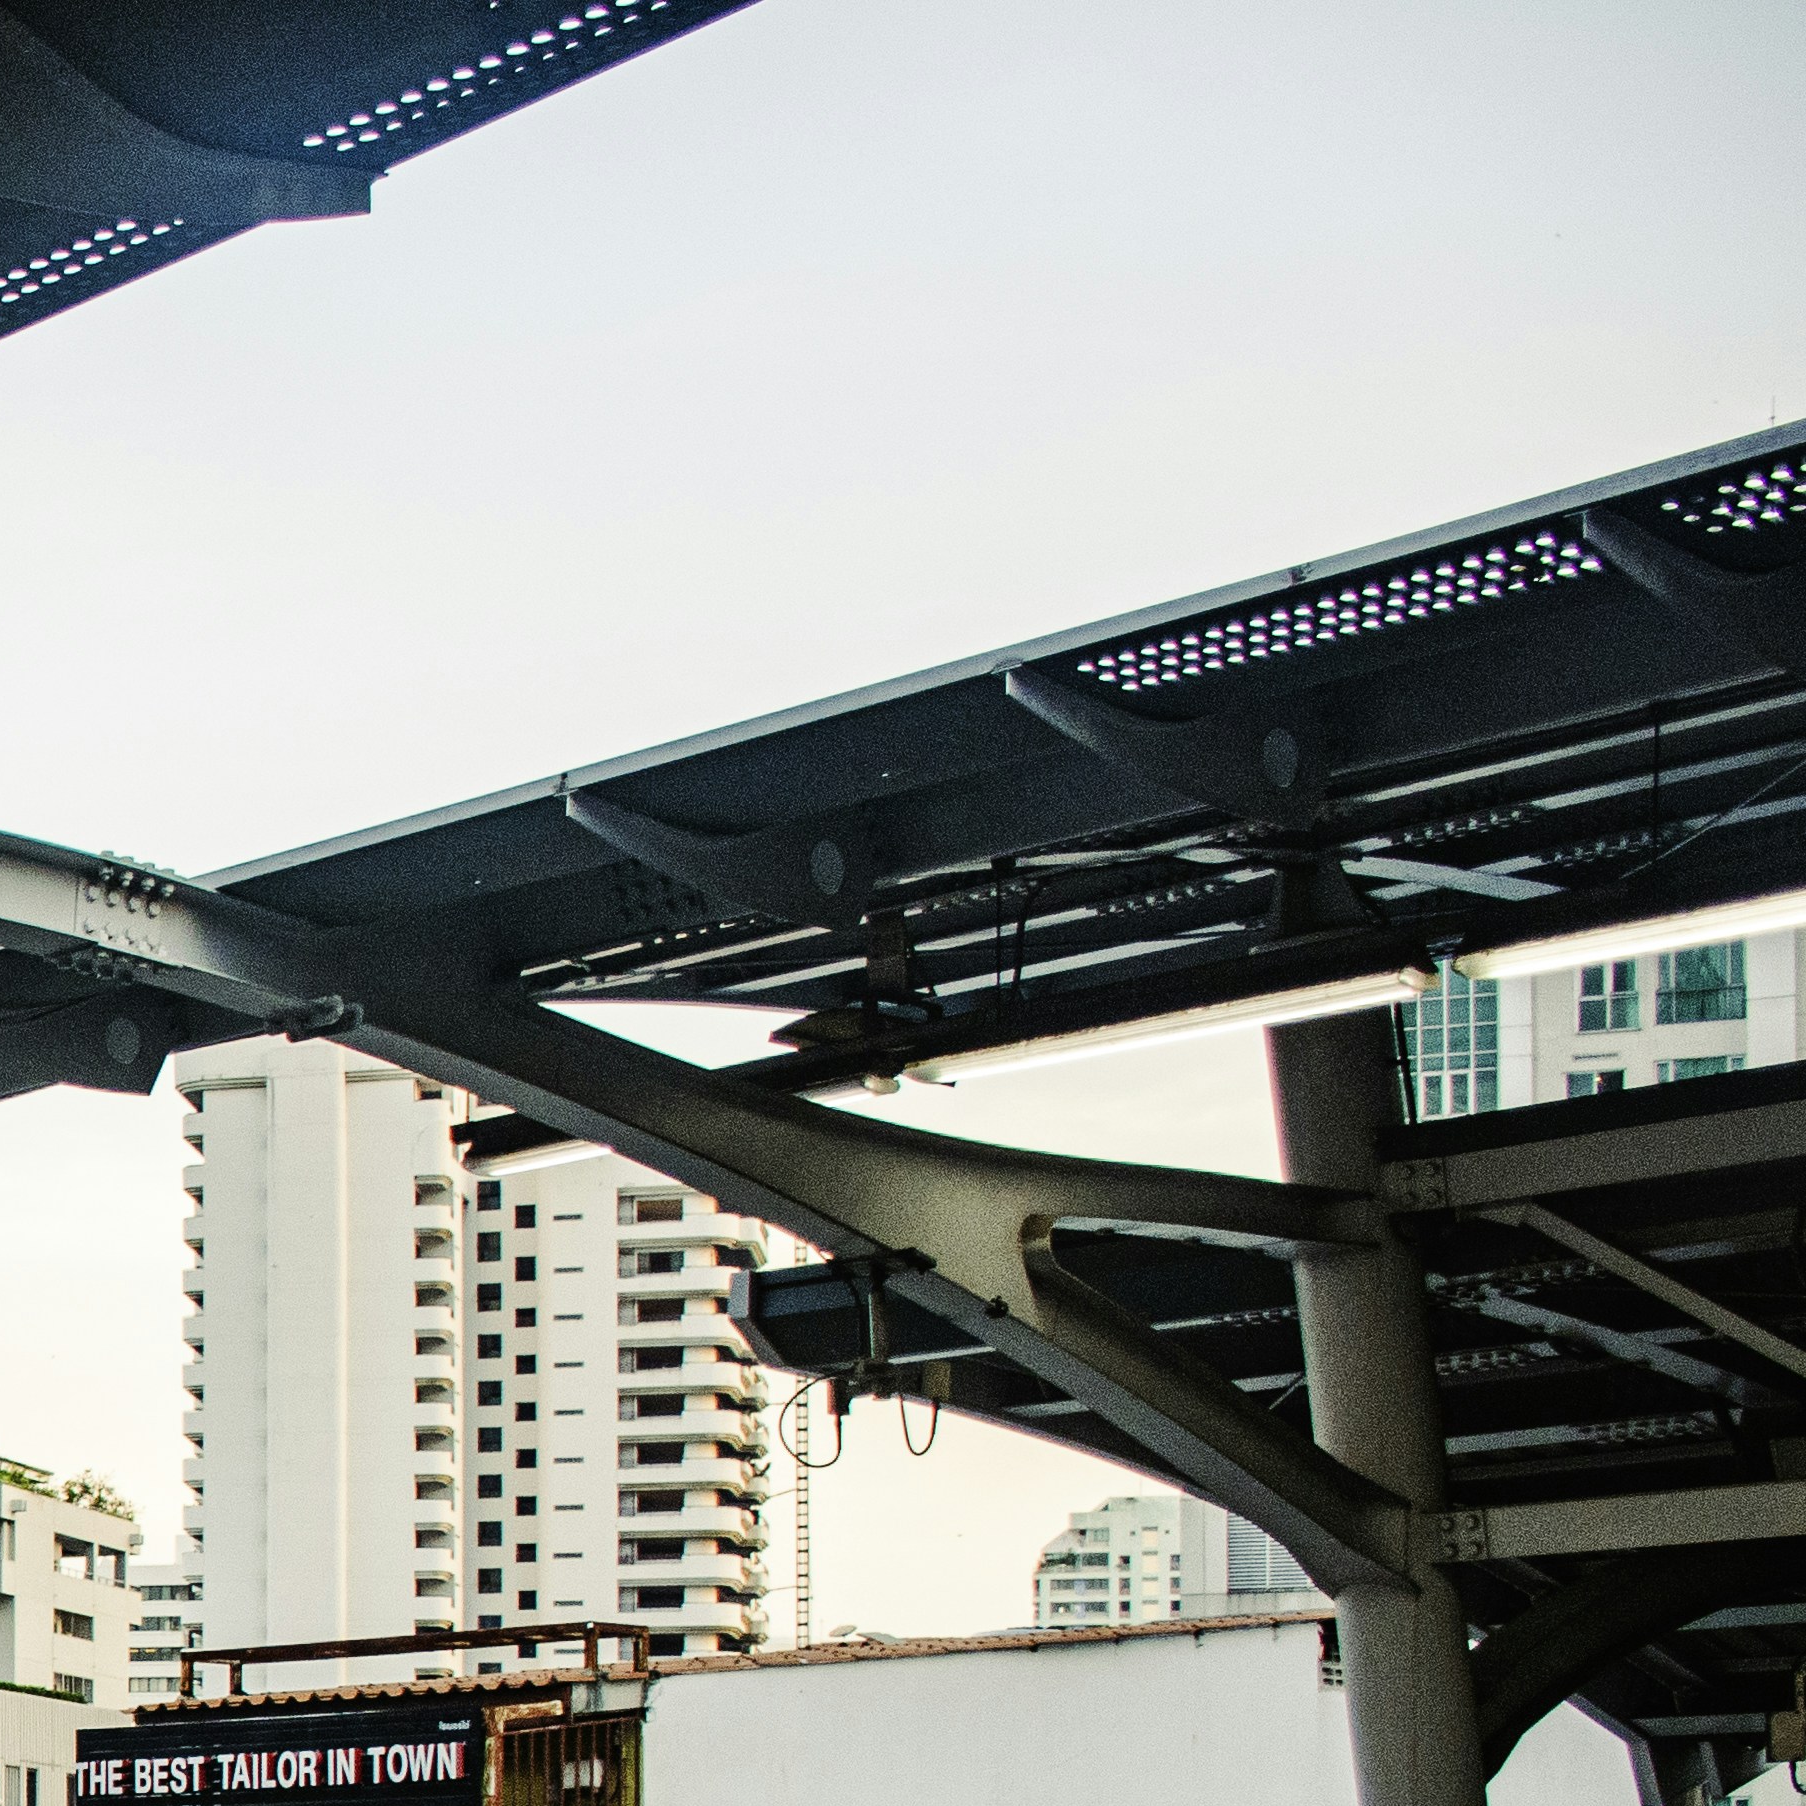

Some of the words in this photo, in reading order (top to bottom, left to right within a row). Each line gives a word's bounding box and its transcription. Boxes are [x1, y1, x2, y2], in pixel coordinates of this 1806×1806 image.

[76, 1759, 127, 1797] THE
[134, 1755, 207, 1795] BEST
[217, 1750, 320, 1791] TAILOR
[327, 1747, 361, 1786] IN
[367, 1741, 463, 1784] TOWN
